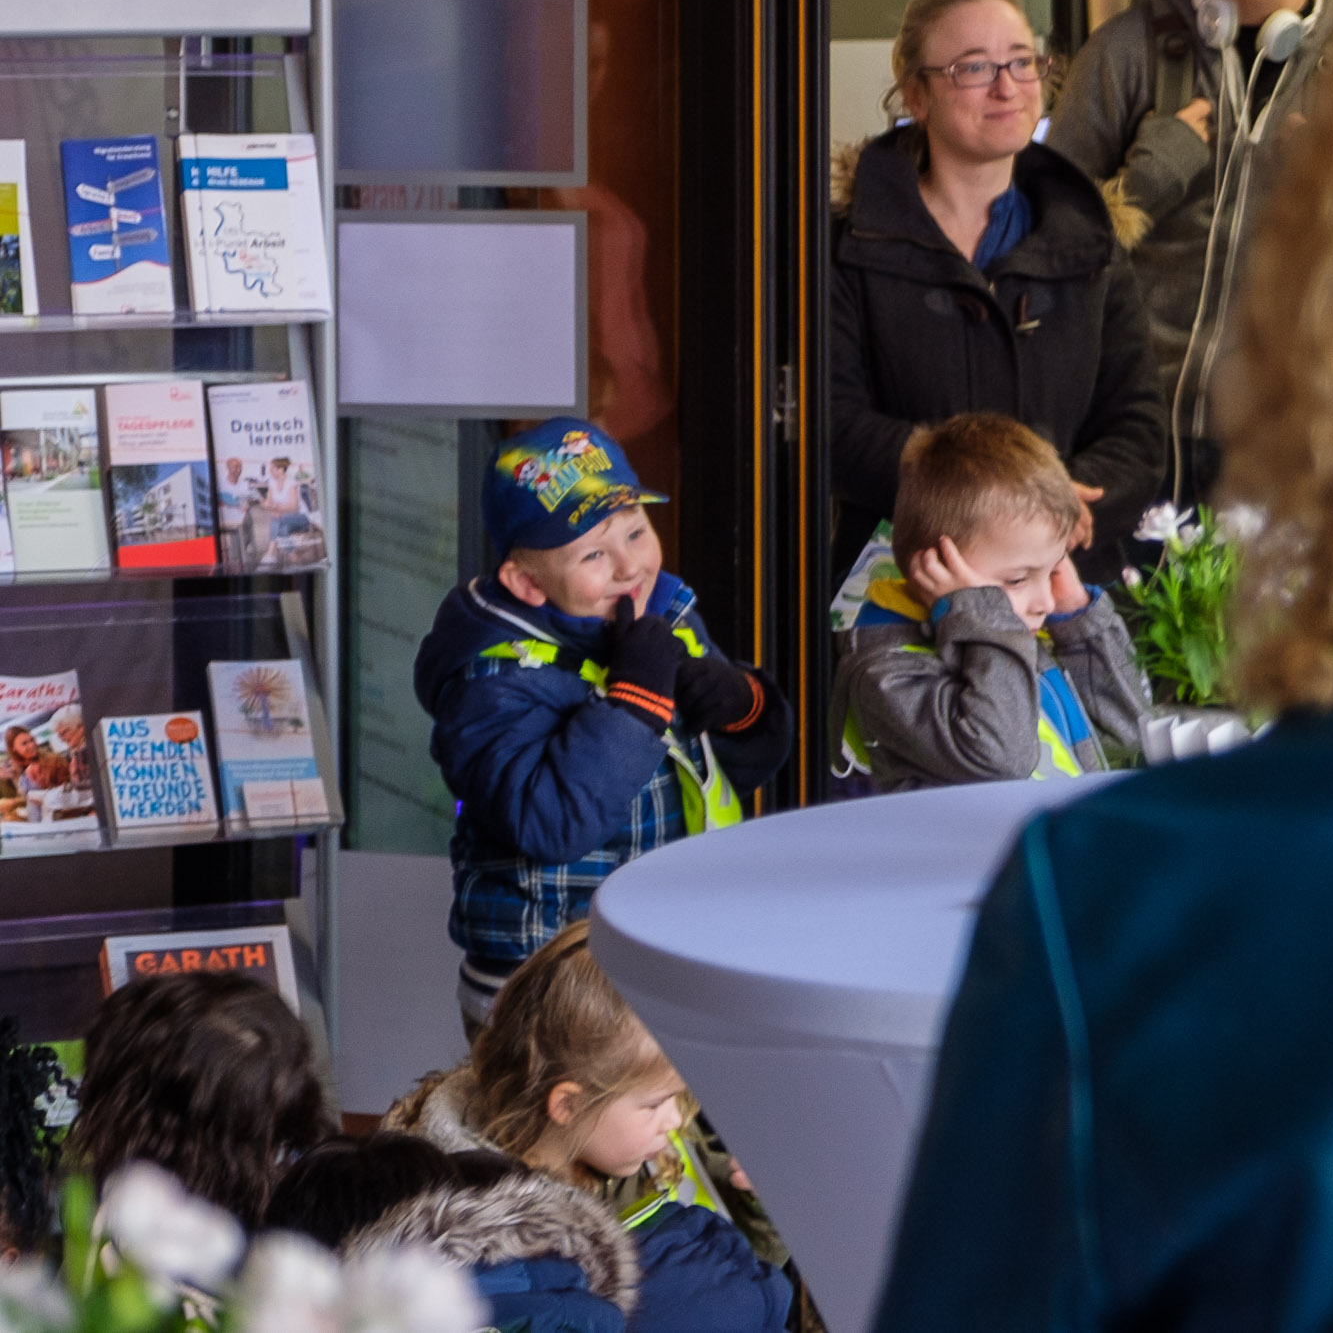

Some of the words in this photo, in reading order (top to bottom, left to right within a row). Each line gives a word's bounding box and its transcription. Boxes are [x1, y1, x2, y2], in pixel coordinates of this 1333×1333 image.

[230, 417, 305, 434] Deutsch
[249, 433, 306, 447] lernen
[107, 719, 151, 738] AUS
[119, 799, 203, 819] WERDEN
[135, 944, 266, 975] GARATH
